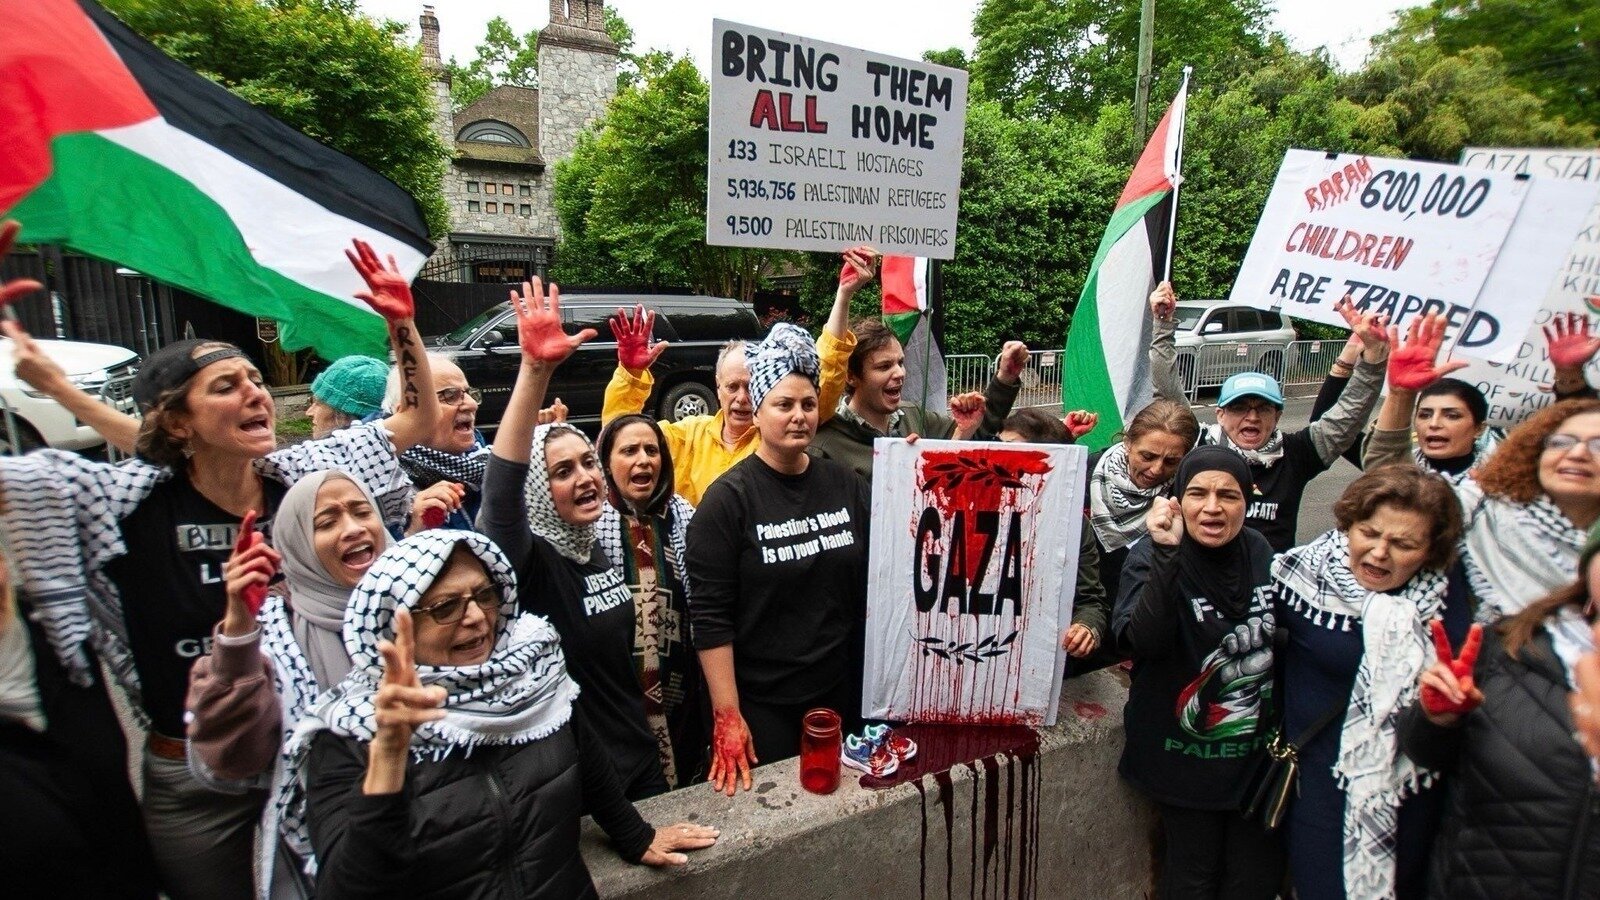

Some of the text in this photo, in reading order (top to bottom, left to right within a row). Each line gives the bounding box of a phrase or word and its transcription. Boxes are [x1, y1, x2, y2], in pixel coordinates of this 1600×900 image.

[722, 30, 952, 111] BRING THEM
[750, 89, 938, 150] ALL HOME
[728, 139, 923, 177] 133 ISRAELI HOSTAGES
[727, 179, 947, 209] 5,936,756 PALESTINIAN REFUGEES
[1305, 156, 1491, 221] RAFAH 600,000
[727, 215, 948, 247] 9,500 PALESTINIAN PRISONERS
[1286, 222, 1414, 271] CHILDREN
[1270, 268, 1331, 304] ARE
[397, 326, 419, 409] RAFAH
[1505, 362, 1551, 384] KILL
[756, 507, 850, 540] Palestine's Blood
[762, 529, 855, 564] is on your hands
[914, 506, 1022, 616] GAZA
